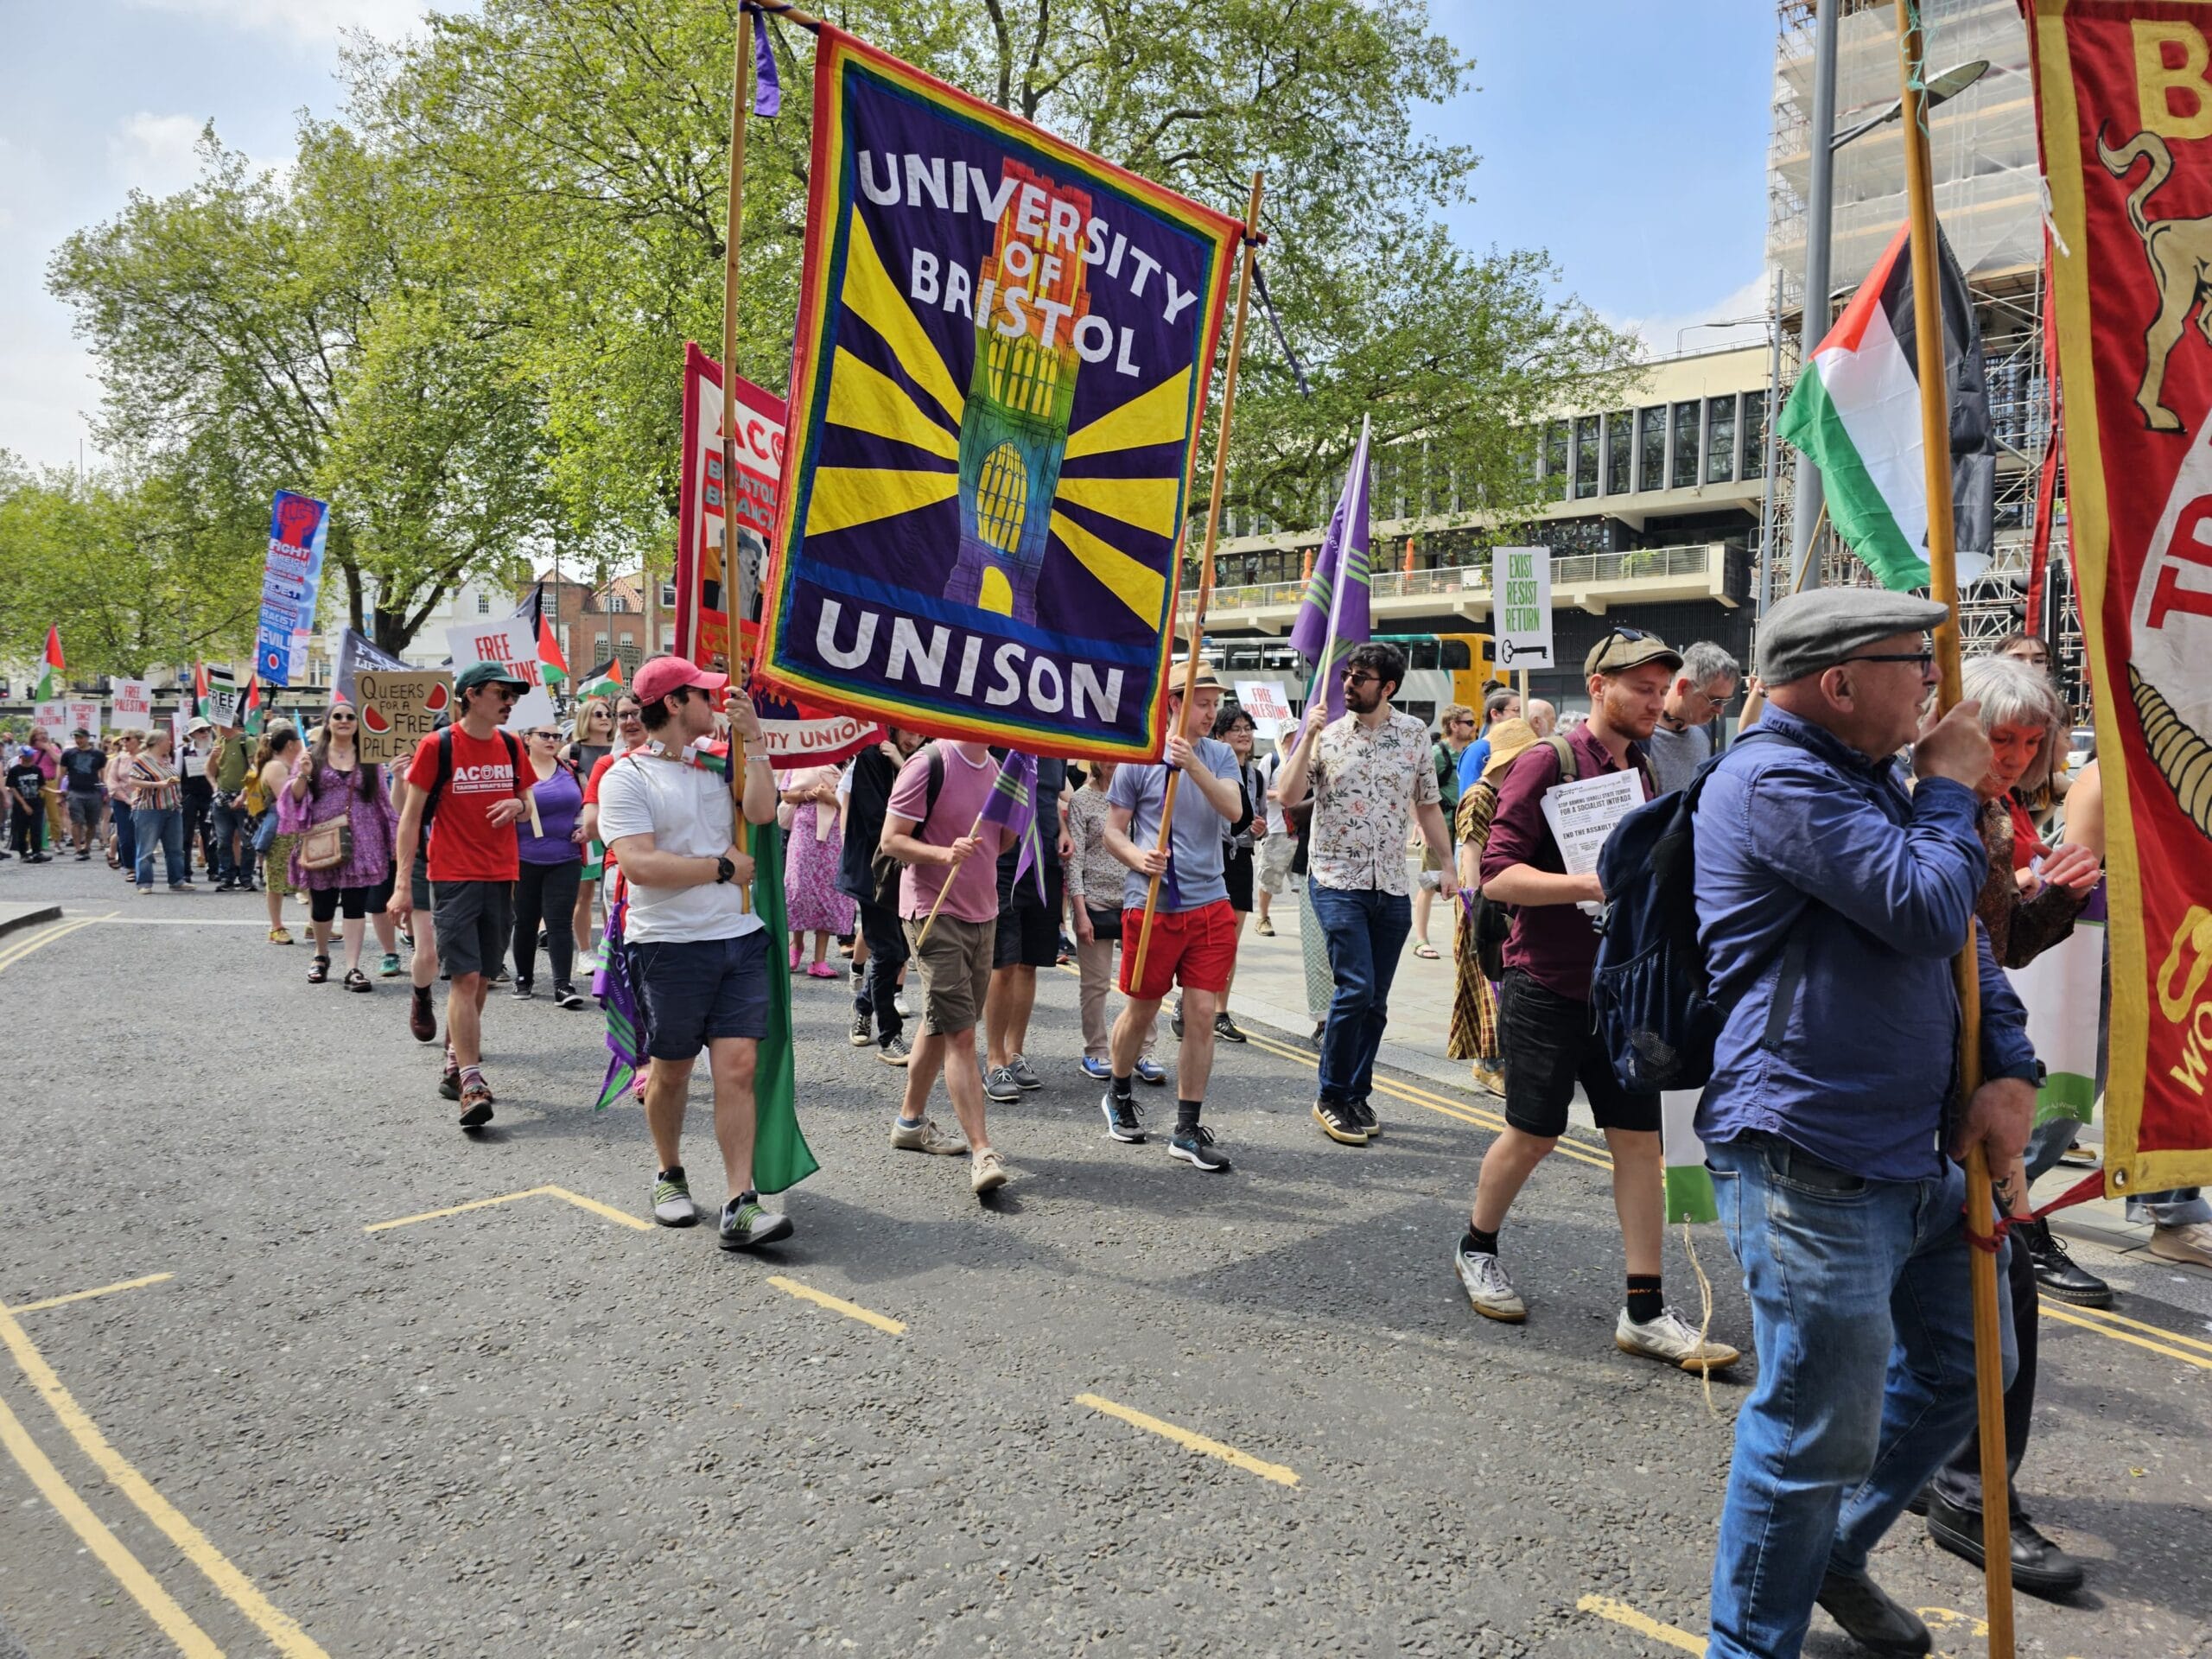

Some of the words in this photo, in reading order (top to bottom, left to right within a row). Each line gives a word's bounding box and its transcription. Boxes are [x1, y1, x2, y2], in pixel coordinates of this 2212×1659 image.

[858, 149, 1198, 325] UNIVERSITY
[1005, 240, 1062, 288] OF
[911, 247, 1141, 378] BRISTOL
[708, 458, 777, 507] BISTOL
[705, 485, 774, 531] BANCH
[270, 538, 310, 559] FIGHT
[1509, 554, 1534, 580] EXIST
[264, 581, 300, 600] REJECT
[1506, 580, 1538, 606] RESIST
[261, 607, 296, 627] RACIST
[1505, 607, 1541, 632] RETURN
[475, 633, 513, 661] FREE
[816, 598, 1124, 724] UNISON
[124, 685, 141, 698] FREE
[361, 676, 424, 700] QUEERS
[1251, 688, 1274, 703] FREE
[43, 706, 54, 715] FREE
[114, 698, 149, 713] PALESTINE
[380, 701, 398, 715] FOR
[402, 701, 410, 711] A
[1243, 702, 1290, 720] PALESTINE
[394, 713, 433, 733] FRE
[800, 720, 869, 748] UNION
[363, 737, 421, 758] PALES
[452, 765, 513, 782] ACORN
[1560, 807, 1571, 816] FOR
[1577, 800, 1605, 812] SOCIALIST
[1606, 794, 1632, 805] INTIFADA
[1569, 798, 1586, 806] ARMING
[1563, 831, 1574, 840] END
[1575, 829, 1586, 837] THE
[1586, 823, 1612, 835] ASSAULT
